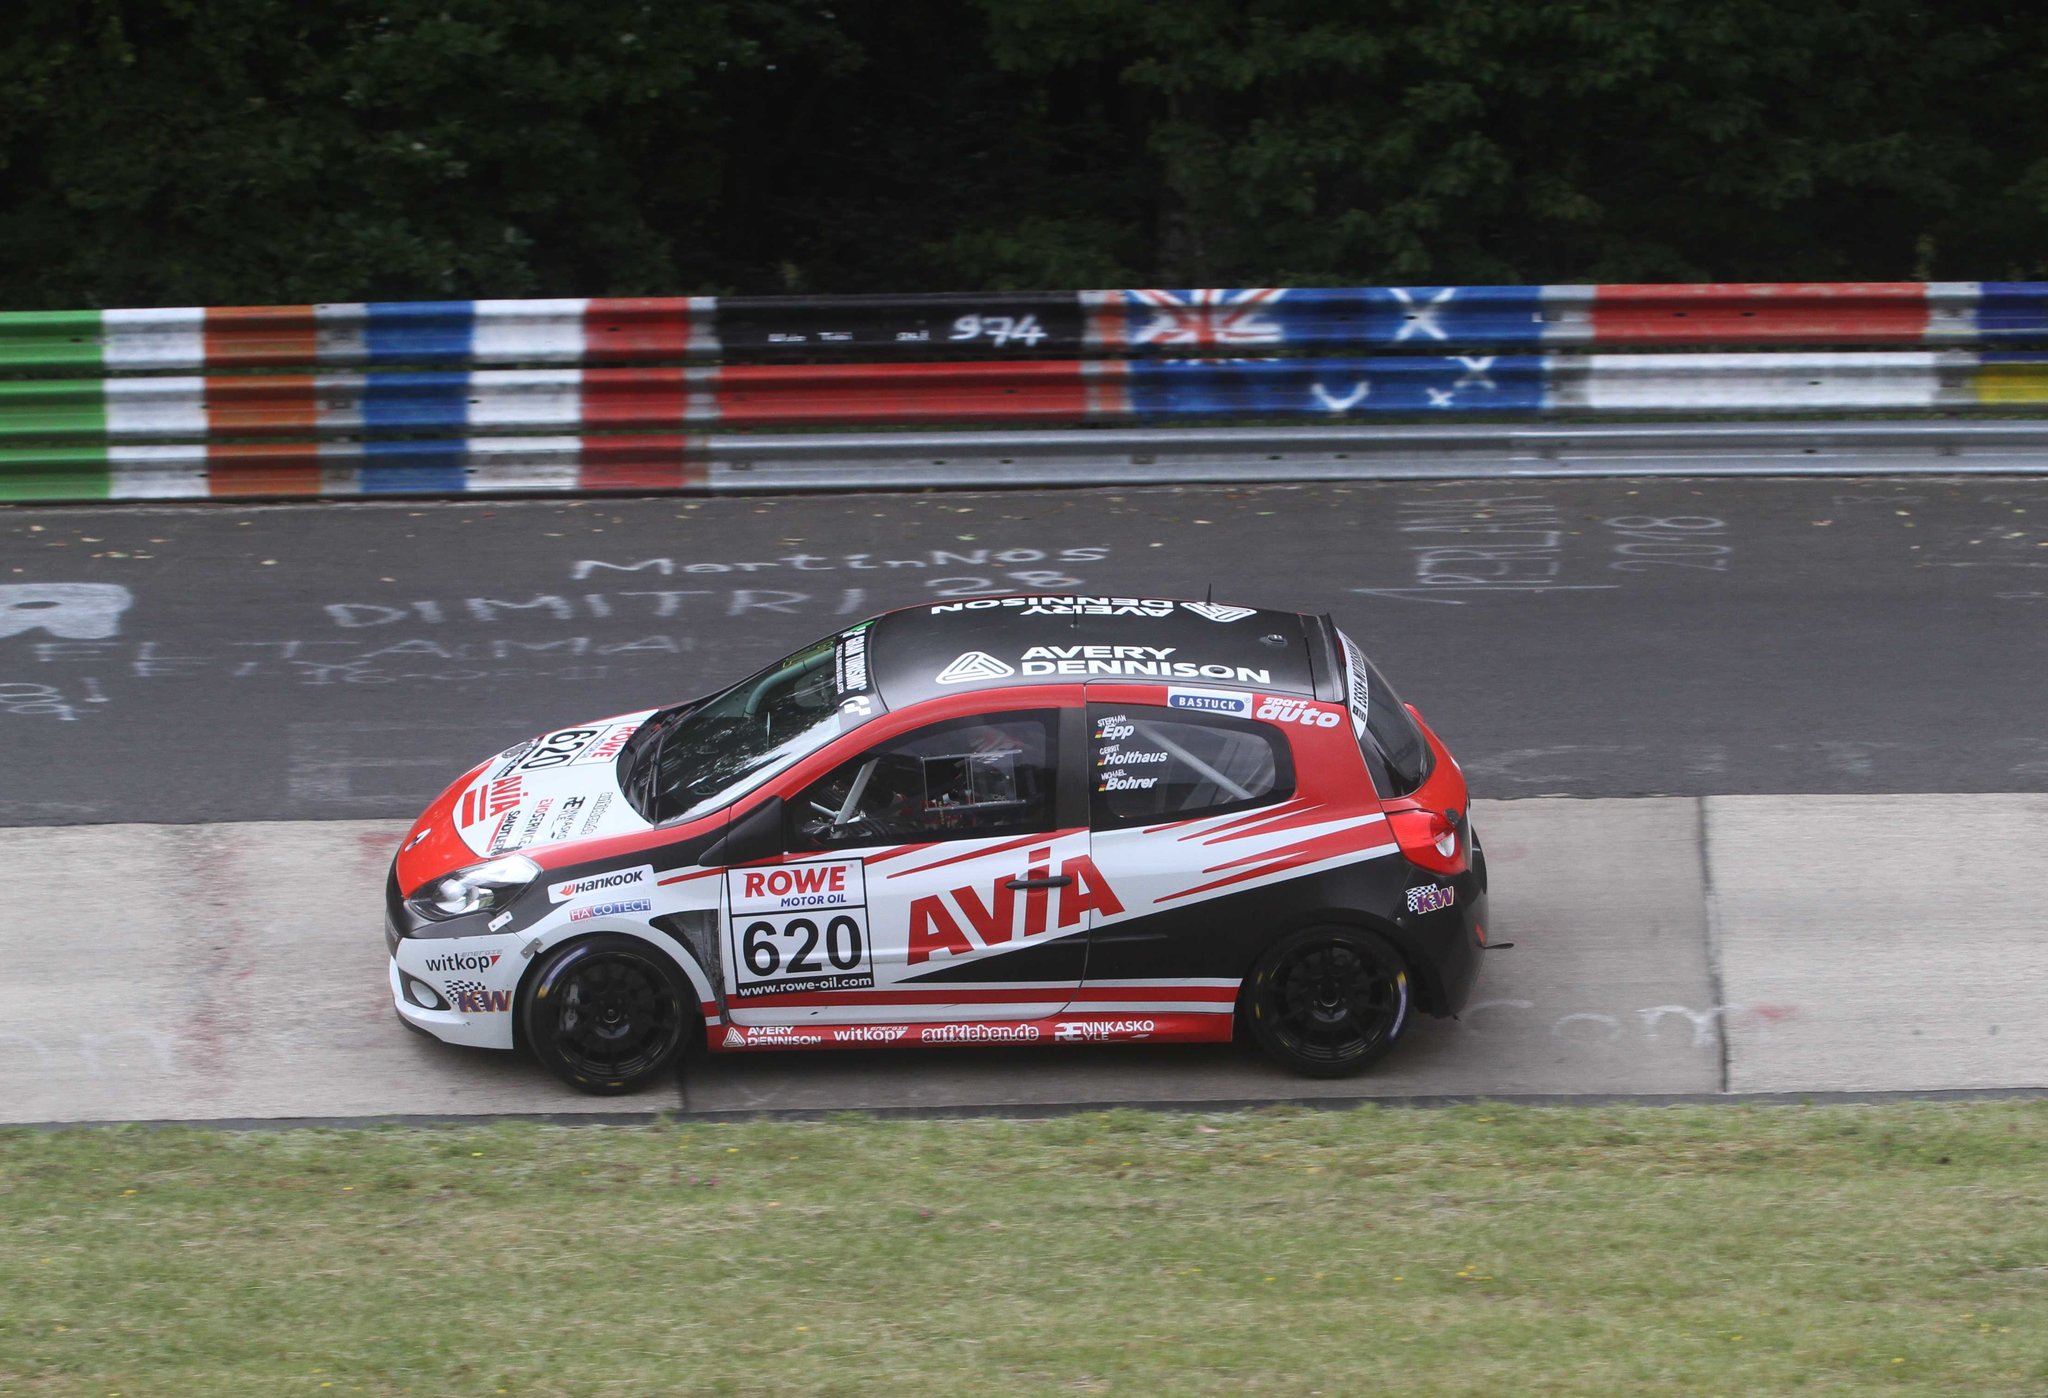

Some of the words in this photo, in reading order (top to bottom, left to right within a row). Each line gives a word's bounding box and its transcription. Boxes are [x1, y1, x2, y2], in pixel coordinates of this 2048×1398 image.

[949, 314, 1047, 347] 974
[931, 597, 1175, 616] DENNISON
[1021, 604, 1175, 618] AVERY
[1020, 645, 1178, 660] AVERY
[1021, 660, 1271, 684] DENNISON
[1178, 696, 1237, 711] BASTUCK
[1262, 696, 1309, 710] sport
[1256, 704, 1340, 727] auto
[1102, 724, 1135, 740] Epp
[519, 730, 597, 770] 620
[1103, 750, 1168, 765] Holthaus
[1105, 776, 1158, 791] Bohrer
[744, 865, 846, 898] ROWE
[780, 896, 824, 907] MOTOR
[827, 893, 847, 904] OIL
[1417, 886, 1455, 914] KW
[742, 915, 863, 976] 620
[425, 953, 490, 973] witkop
[739, 977, 872, 997] www.rowe-oil.com
[456, 990, 512, 1012] KW
[748, 1026, 795, 1036] AVERY
[748, 1035, 822, 1046] DENNISON
[834, 1026, 898, 1043] witkop
[922, 1024, 1039, 1043] aufkleben.de
